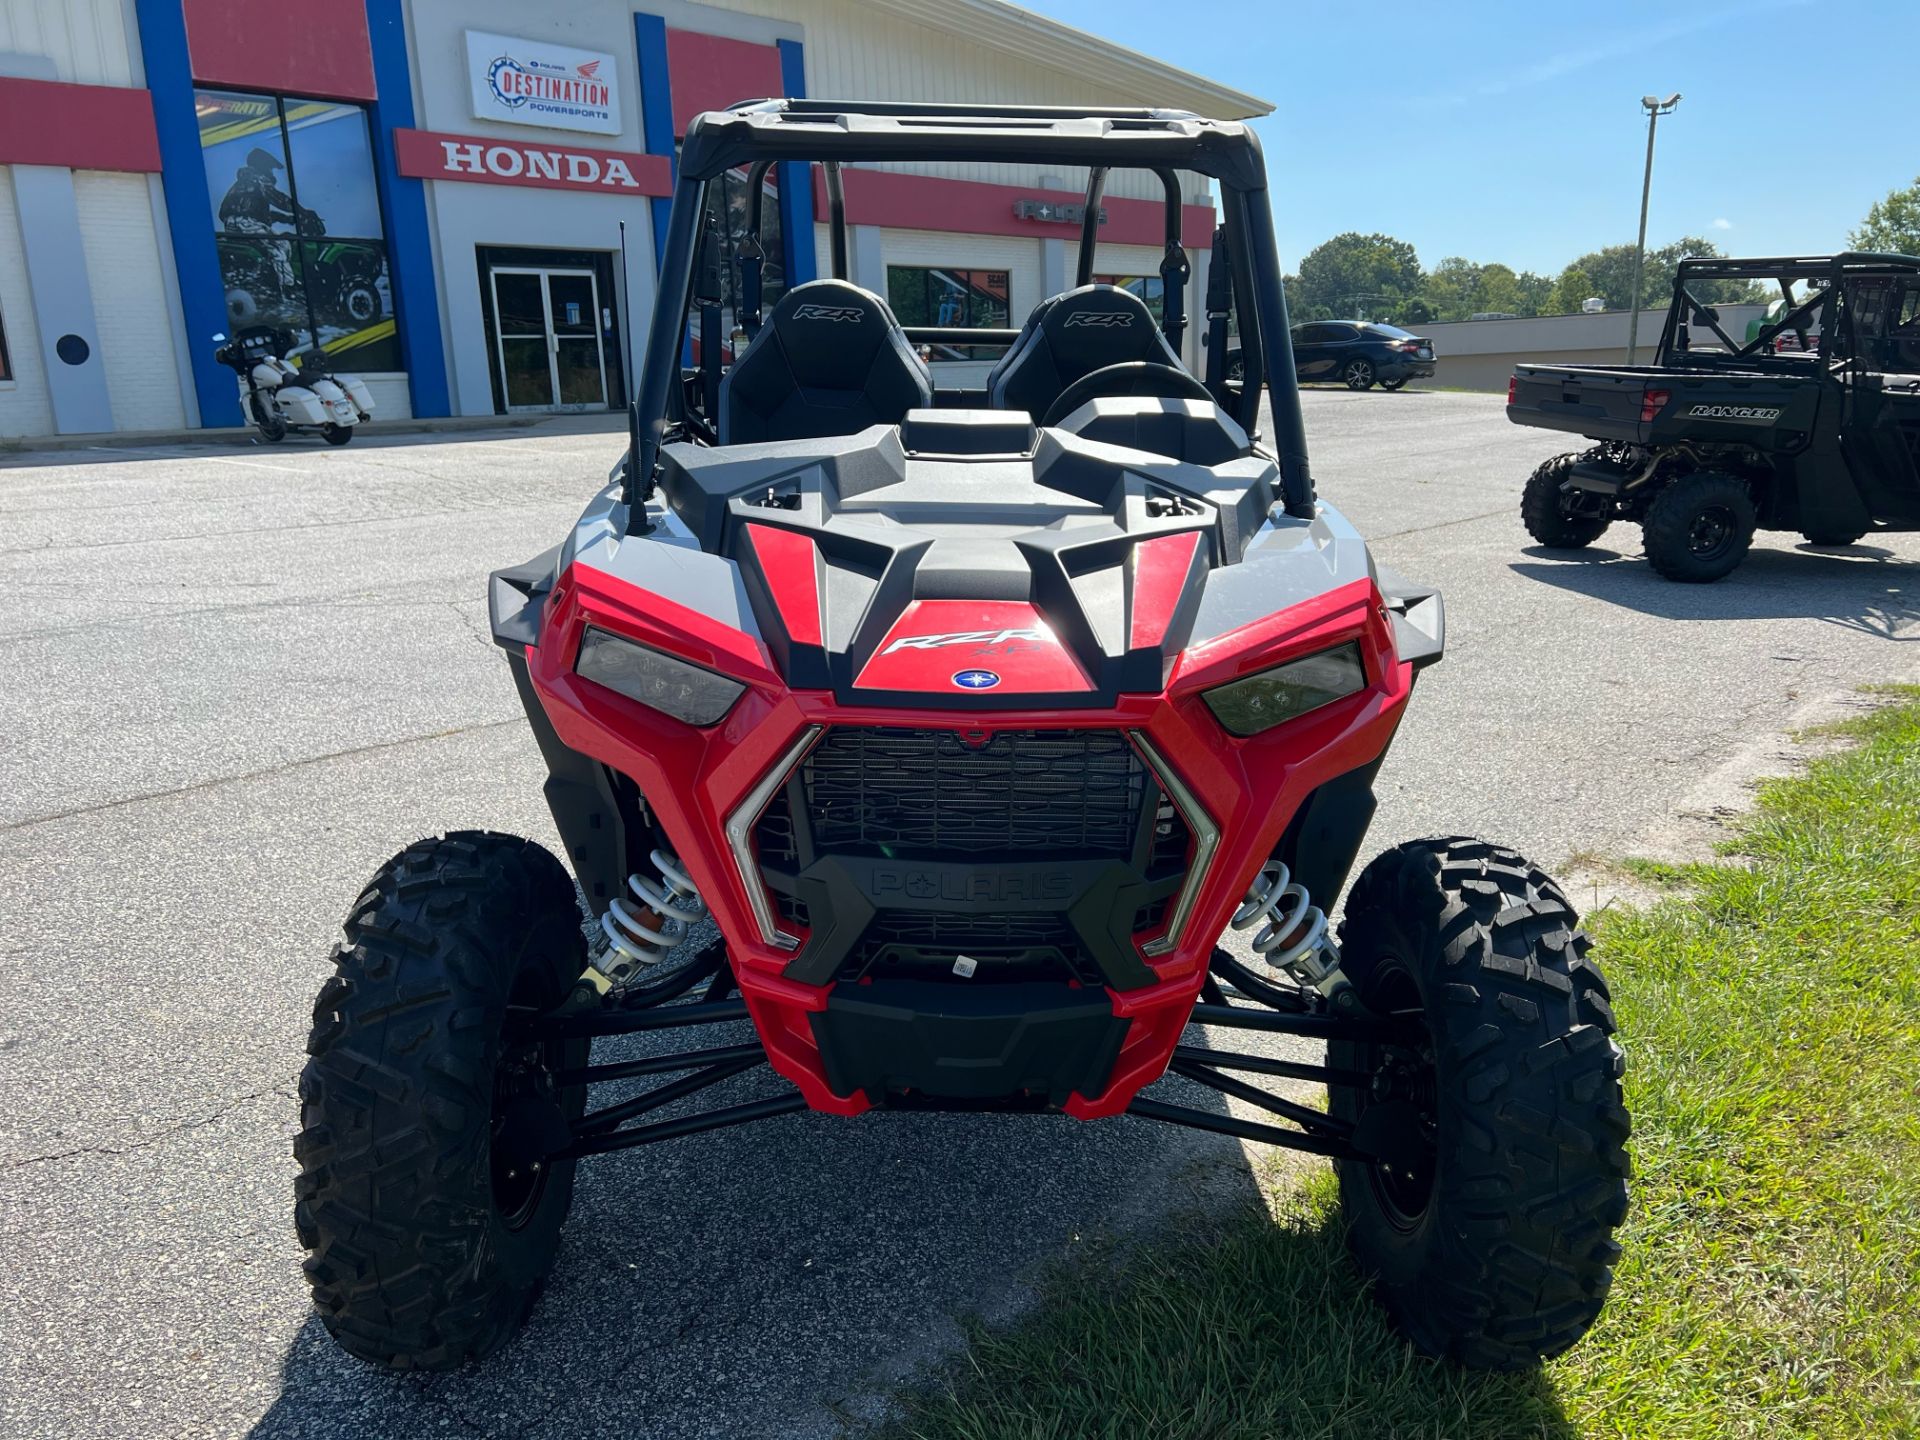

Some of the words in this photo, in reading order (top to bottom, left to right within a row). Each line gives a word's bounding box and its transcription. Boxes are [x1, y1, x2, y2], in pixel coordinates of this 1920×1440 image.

[503, 71, 609, 106] DESTINATION
[529, 102, 609, 119] POWERSPORTS
[440, 141, 640, 187] HONDA
[793, 304, 865, 323] RZR
[1063, 311, 1135, 328] RZR
[1688, 405, 1780, 419] RANGER
[878, 629, 1058, 657] RZR
[871, 867, 1074, 903] POLARIS
